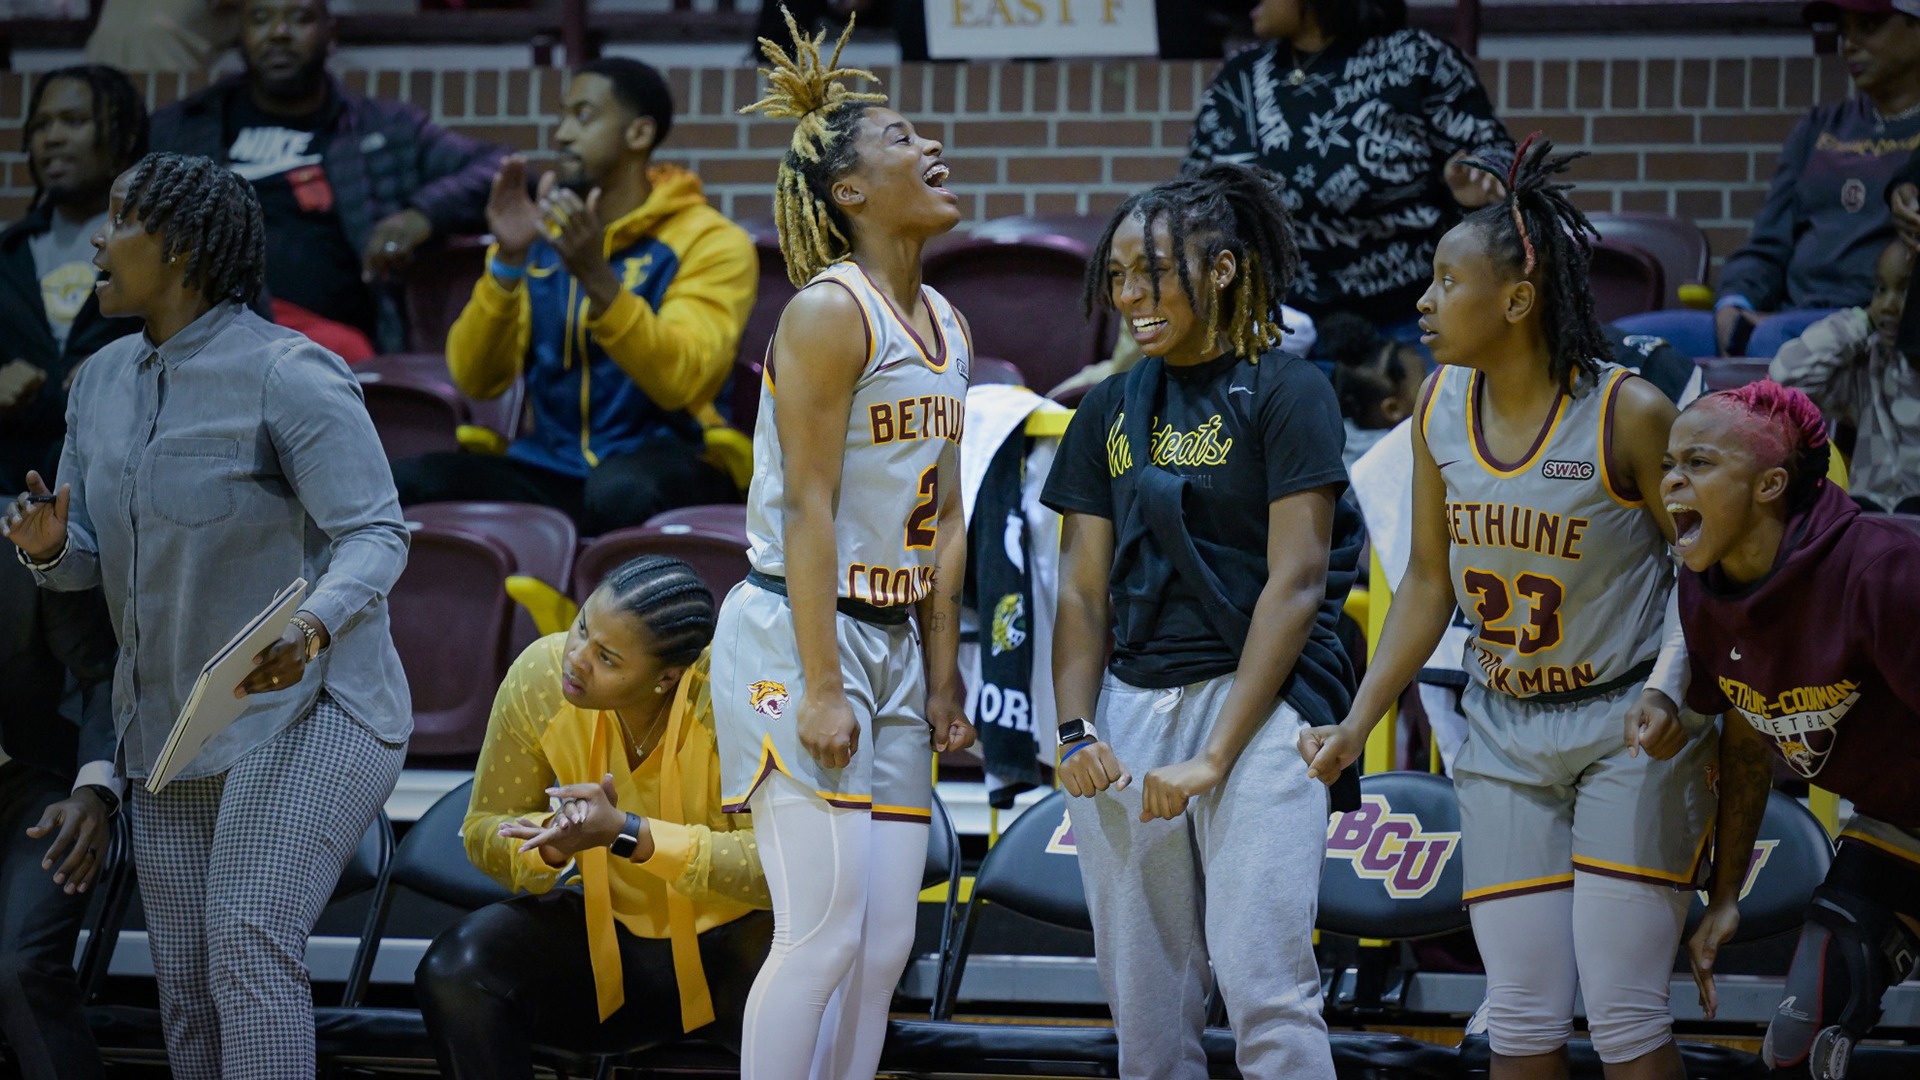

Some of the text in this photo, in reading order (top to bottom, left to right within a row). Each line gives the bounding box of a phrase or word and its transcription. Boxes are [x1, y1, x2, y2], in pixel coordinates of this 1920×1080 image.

[229, 126, 315, 161] NIKE
[868, 394, 965, 446] BETHU
[1106, 412, 1233, 478] Wdcats
[1543, 460, 1594, 479] SWAC
[904, 464, 938, 551] 2
[1463, 566, 1566, 656] 23
[1326, 794, 1461, 899] BCU
